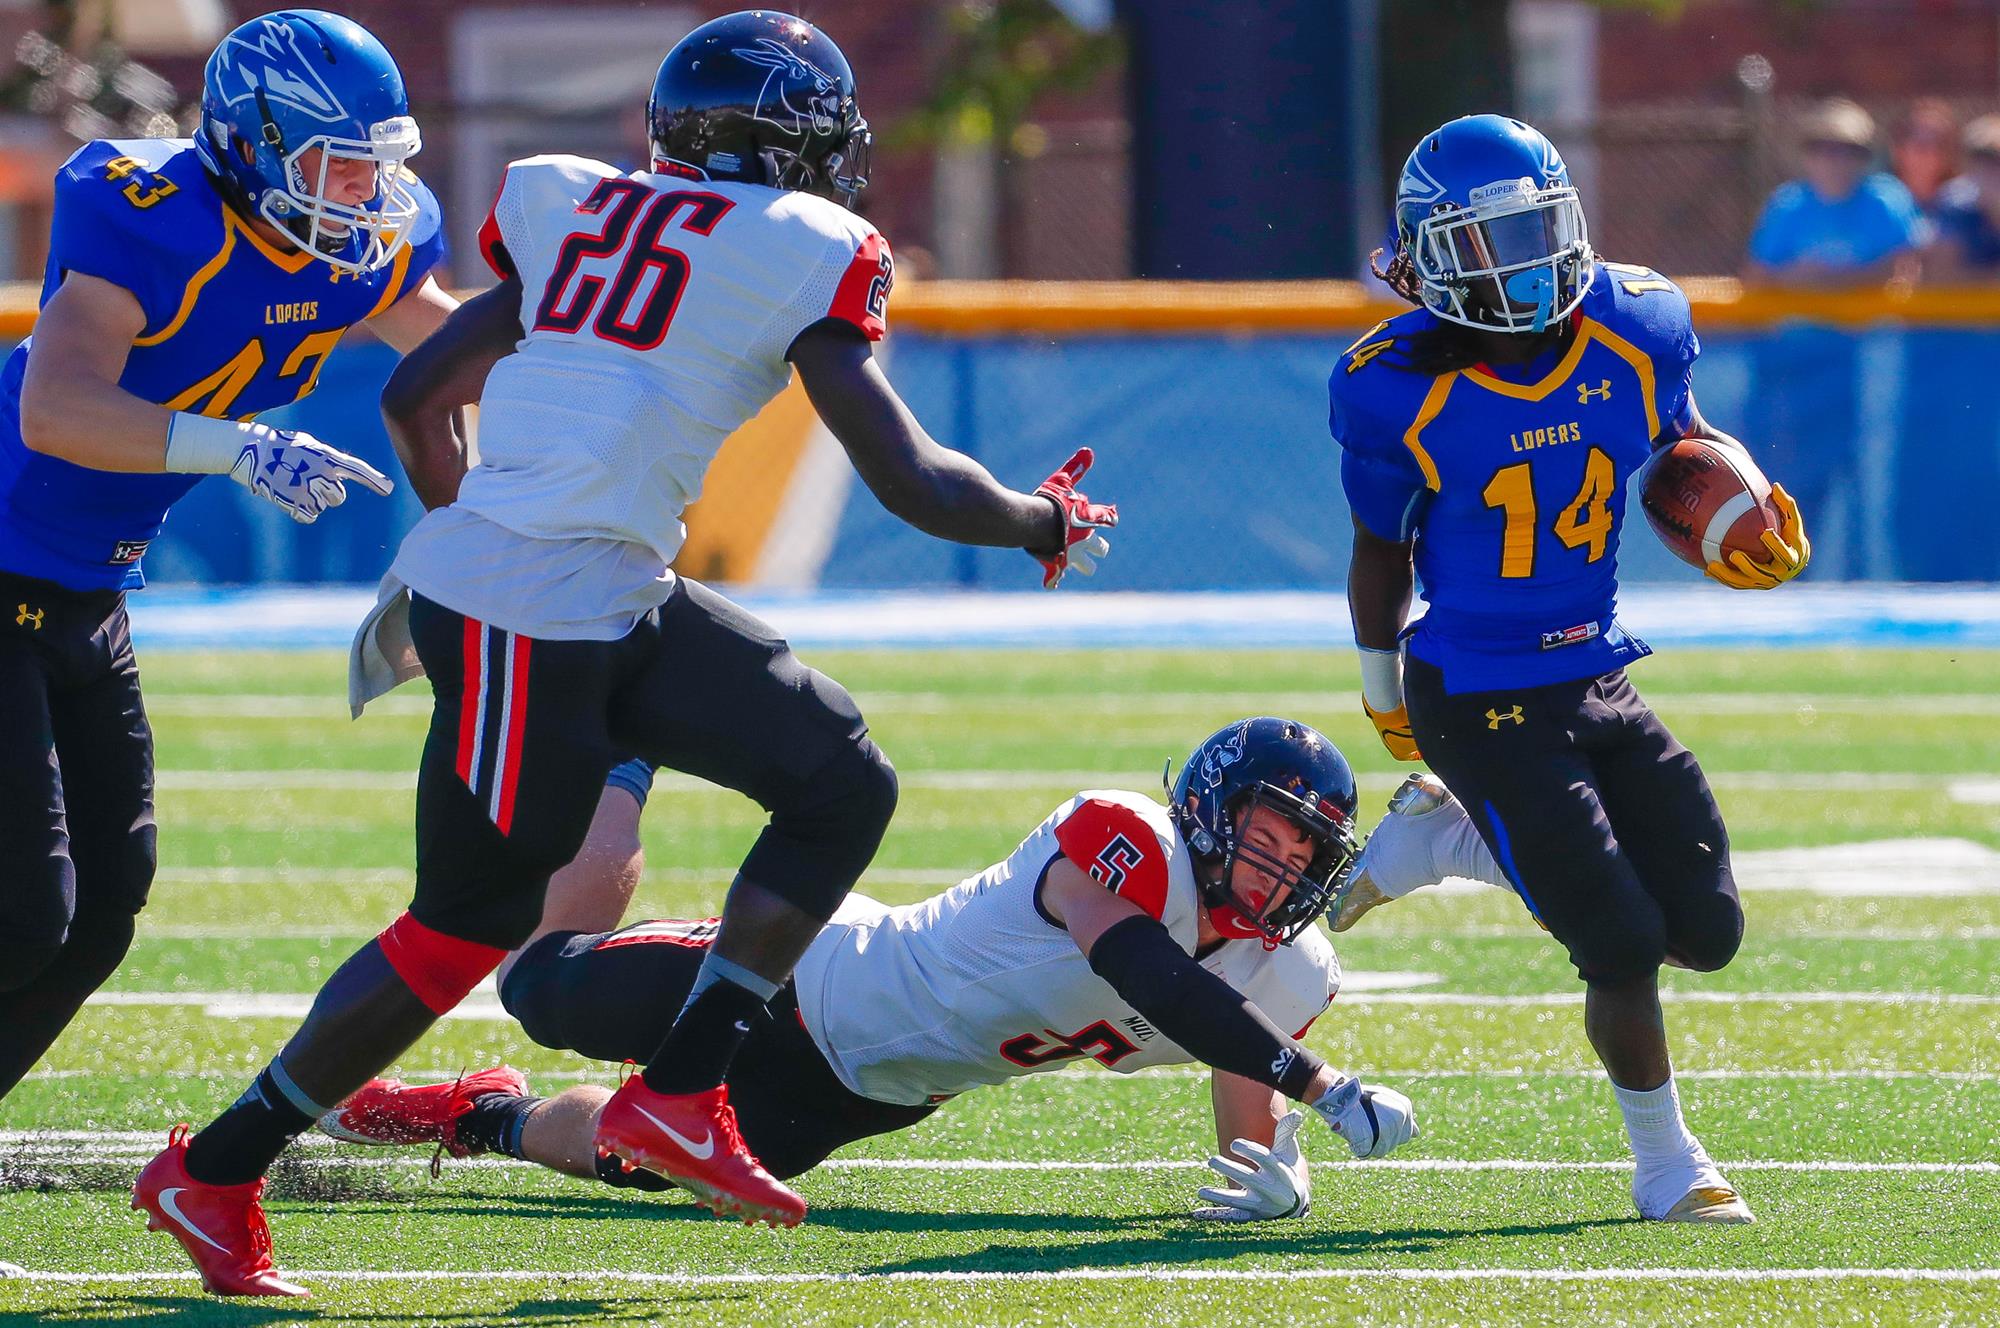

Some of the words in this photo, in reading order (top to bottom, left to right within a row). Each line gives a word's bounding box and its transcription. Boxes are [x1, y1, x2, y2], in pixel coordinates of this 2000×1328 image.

[105, 154, 179, 209] 43
[1485, 184, 1519, 197] LOPERS
[531, 177, 736, 351] 26
[264, 301, 319, 325] LOPERS
[1510, 421, 1582, 453] LOPERS
[1482, 445, 1615, 579] 14
[1089, 832, 1145, 895] 5
[999, 1018, 1144, 1068] 5
